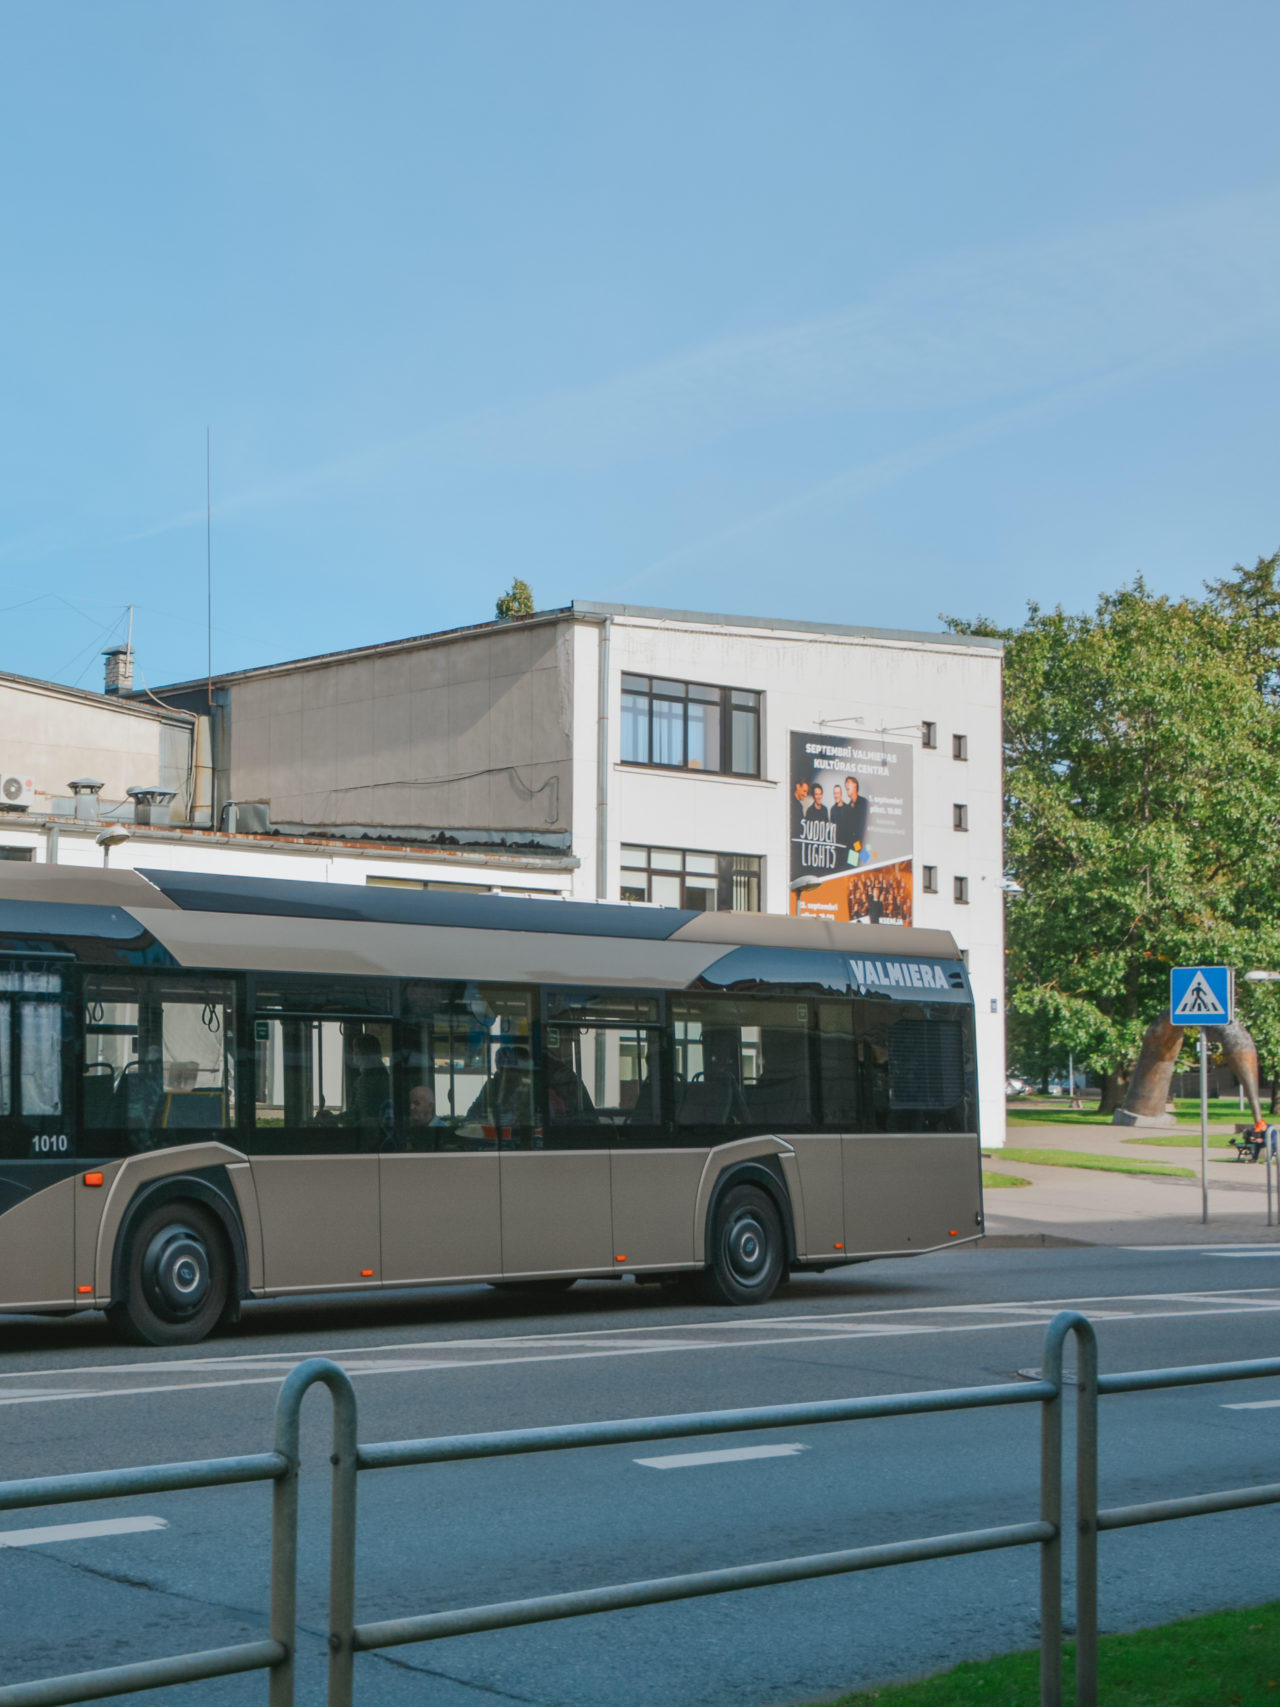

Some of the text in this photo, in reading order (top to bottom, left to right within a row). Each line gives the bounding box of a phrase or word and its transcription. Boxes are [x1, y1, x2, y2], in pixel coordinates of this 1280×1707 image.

[805, 743, 852, 758] SEPTEMBRĪ
[813, 758, 856, 773] KULTŪRAS
[801, 842, 836, 869] LIGHTS
[849, 959, 950, 990] VALMIERA
[31, 1134, 68, 1152] 1010
